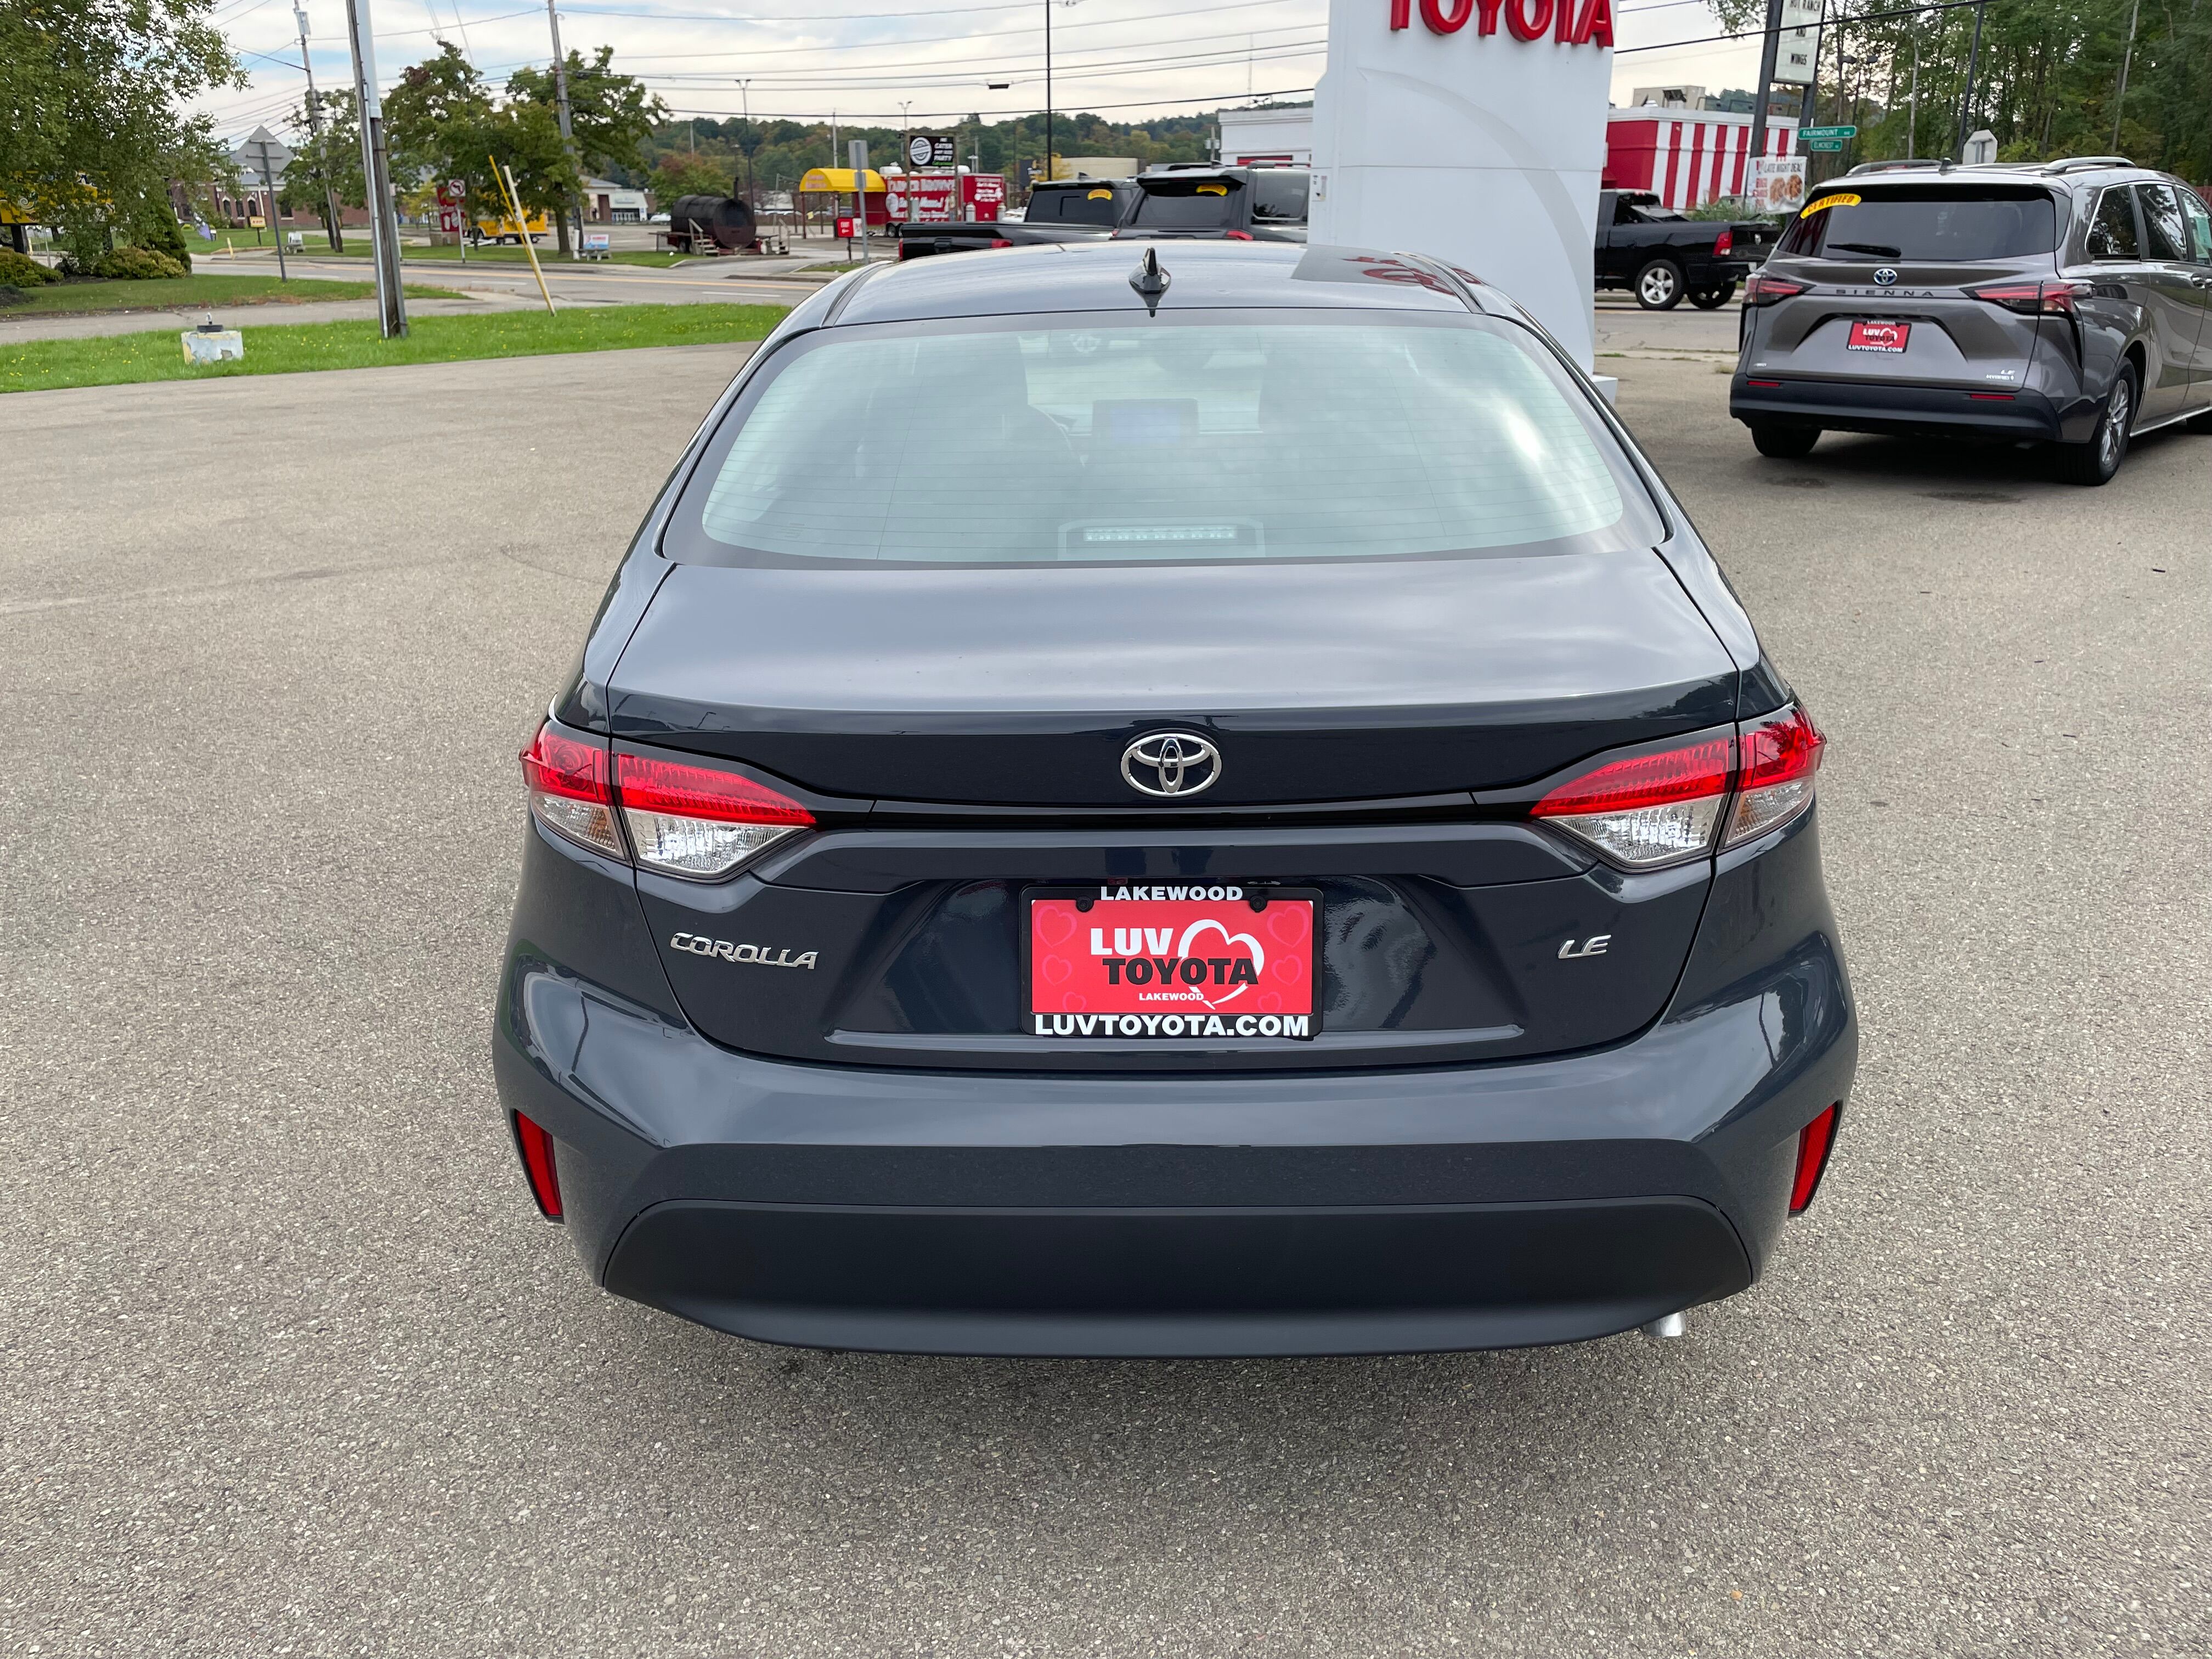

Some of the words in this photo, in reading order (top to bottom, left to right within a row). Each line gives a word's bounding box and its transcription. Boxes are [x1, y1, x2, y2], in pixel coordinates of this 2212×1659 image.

[1791, 53, 1807, 65] WINGS
[1808, 195, 1855, 213] CERTIFIED
[1848, 345, 1903, 353] LUVTOYOTA.COM
[1101, 886, 1243, 901] LAKEWOOD
[670, 932, 819, 969] COROLLA
[1091, 928, 1173, 955] LUV
[1558, 934, 1612, 959] LE
[1102, 957, 1259, 985] TOYOTA
[1138, 992, 1204, 1001] LAKEWOOD
[1035, 1014, 1309, 1036] LUVTOYOTA.COM
